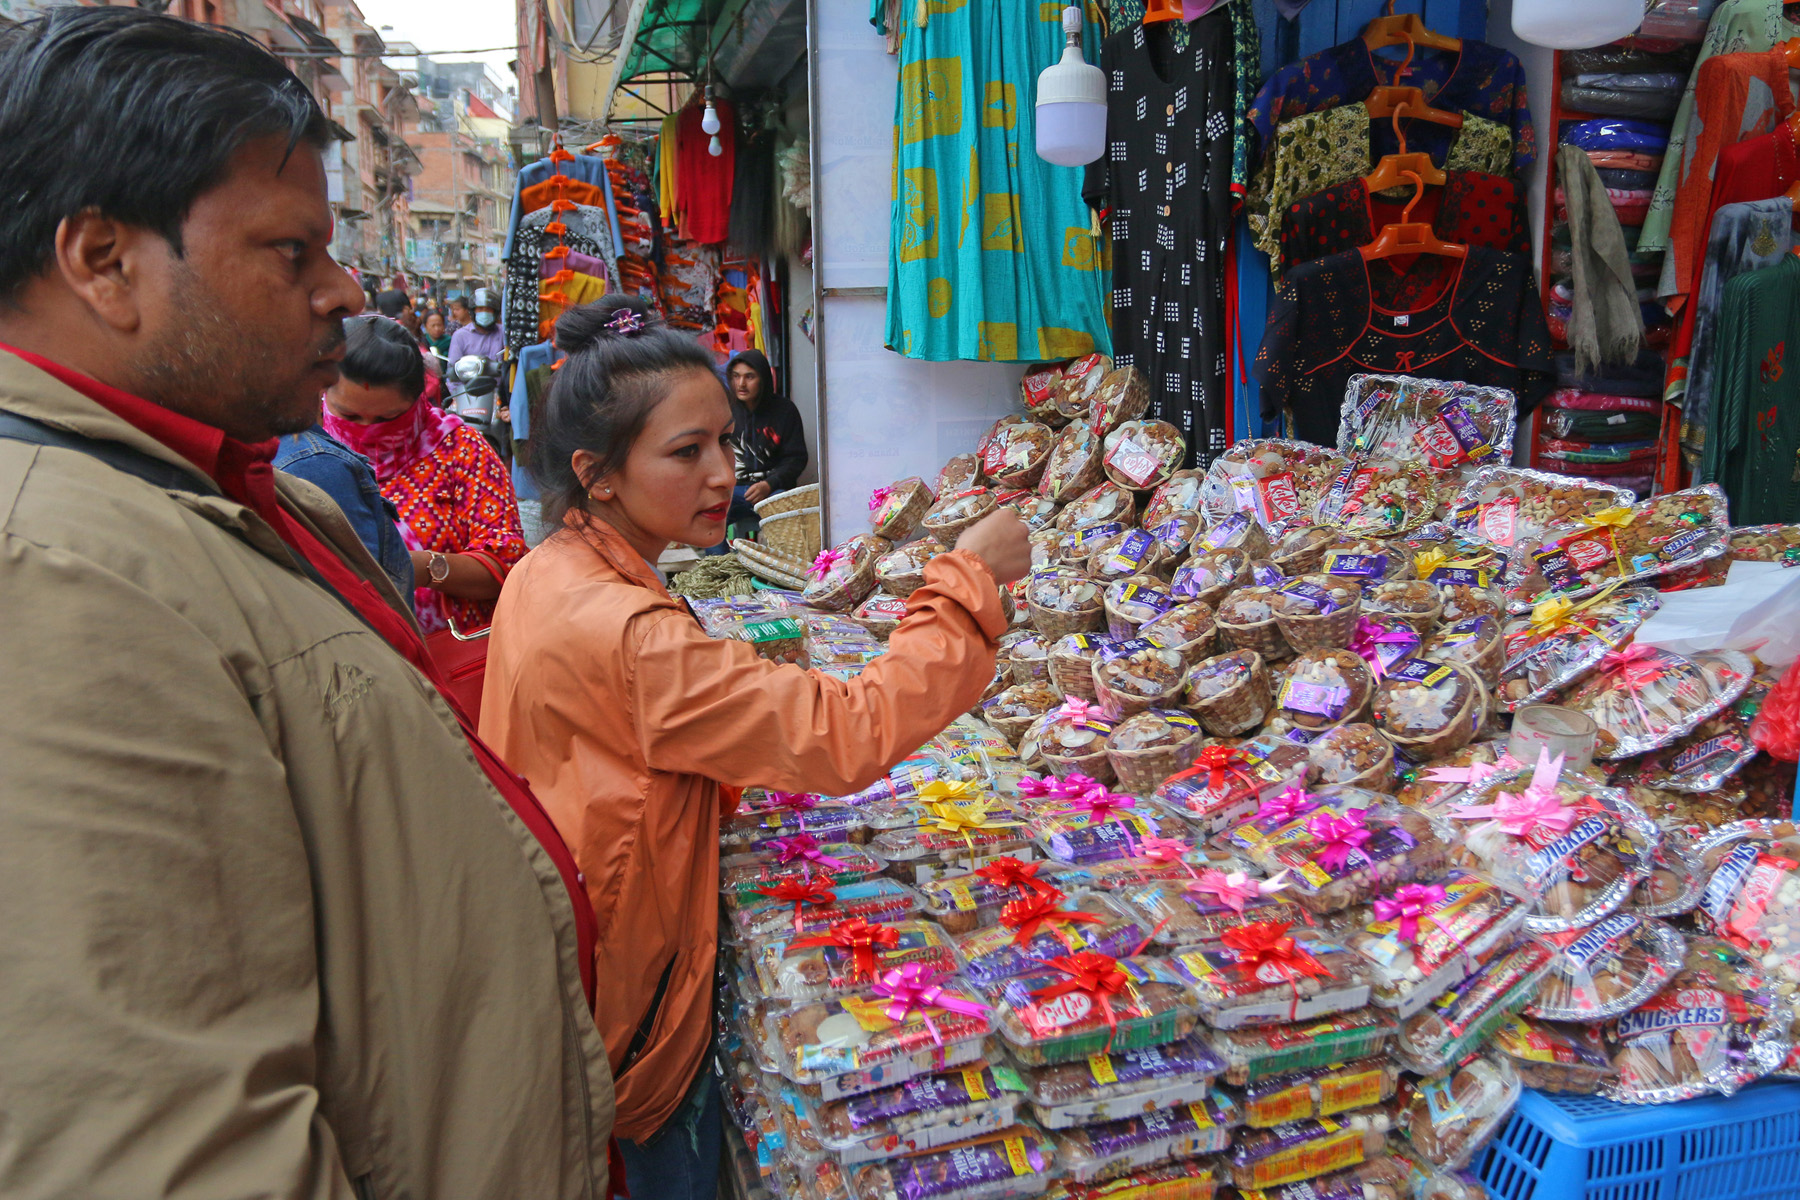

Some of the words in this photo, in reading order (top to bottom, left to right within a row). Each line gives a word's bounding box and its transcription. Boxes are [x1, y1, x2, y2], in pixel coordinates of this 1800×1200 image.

[1028, 371, 1053, 390] KitKat
[1457, 422, 1474, 434] Milk
[1457, 425, 1477, 440] Dairy
[1124, 451, 1153, 477] KitKat
[1271, 480, 1298, 512] KitKat
[1487, 507, 1511, 541] KitKat
[1125, 543, 1141, 552] Dairy
[1128, 540, 1142, 548] Milk
[1343, 554, 1353, 570] Dairy
[1349, 556, 1358, 569] Milk
[1405, 660, 1427, 679] Dairy
[1300, 686, 1310, 706] Dairy
[1305, 689, 1314, 706] Milk
[1094, 824, 1109, 844] Milk
[1104, 822, 1119, 843] Dairy
[1529, 817, 1606, 876] SNICKERS
[1697, 843, 1758, 914] SNICKERS
[1436, 889, 1460, 909] Luk
[1567, 915, 1636, 960] SNICKERS
[882, 949, 942, 968] Chocoz
[1619, 1007, 1722, 1034] SNICKERS
[967, 1076, 980, 1094] Extra
[950, 1148, 970, 1180] Milk
[960, 1145, 981, 1179] Dairy
[1008, 1146, 1023, 1169] Extra
